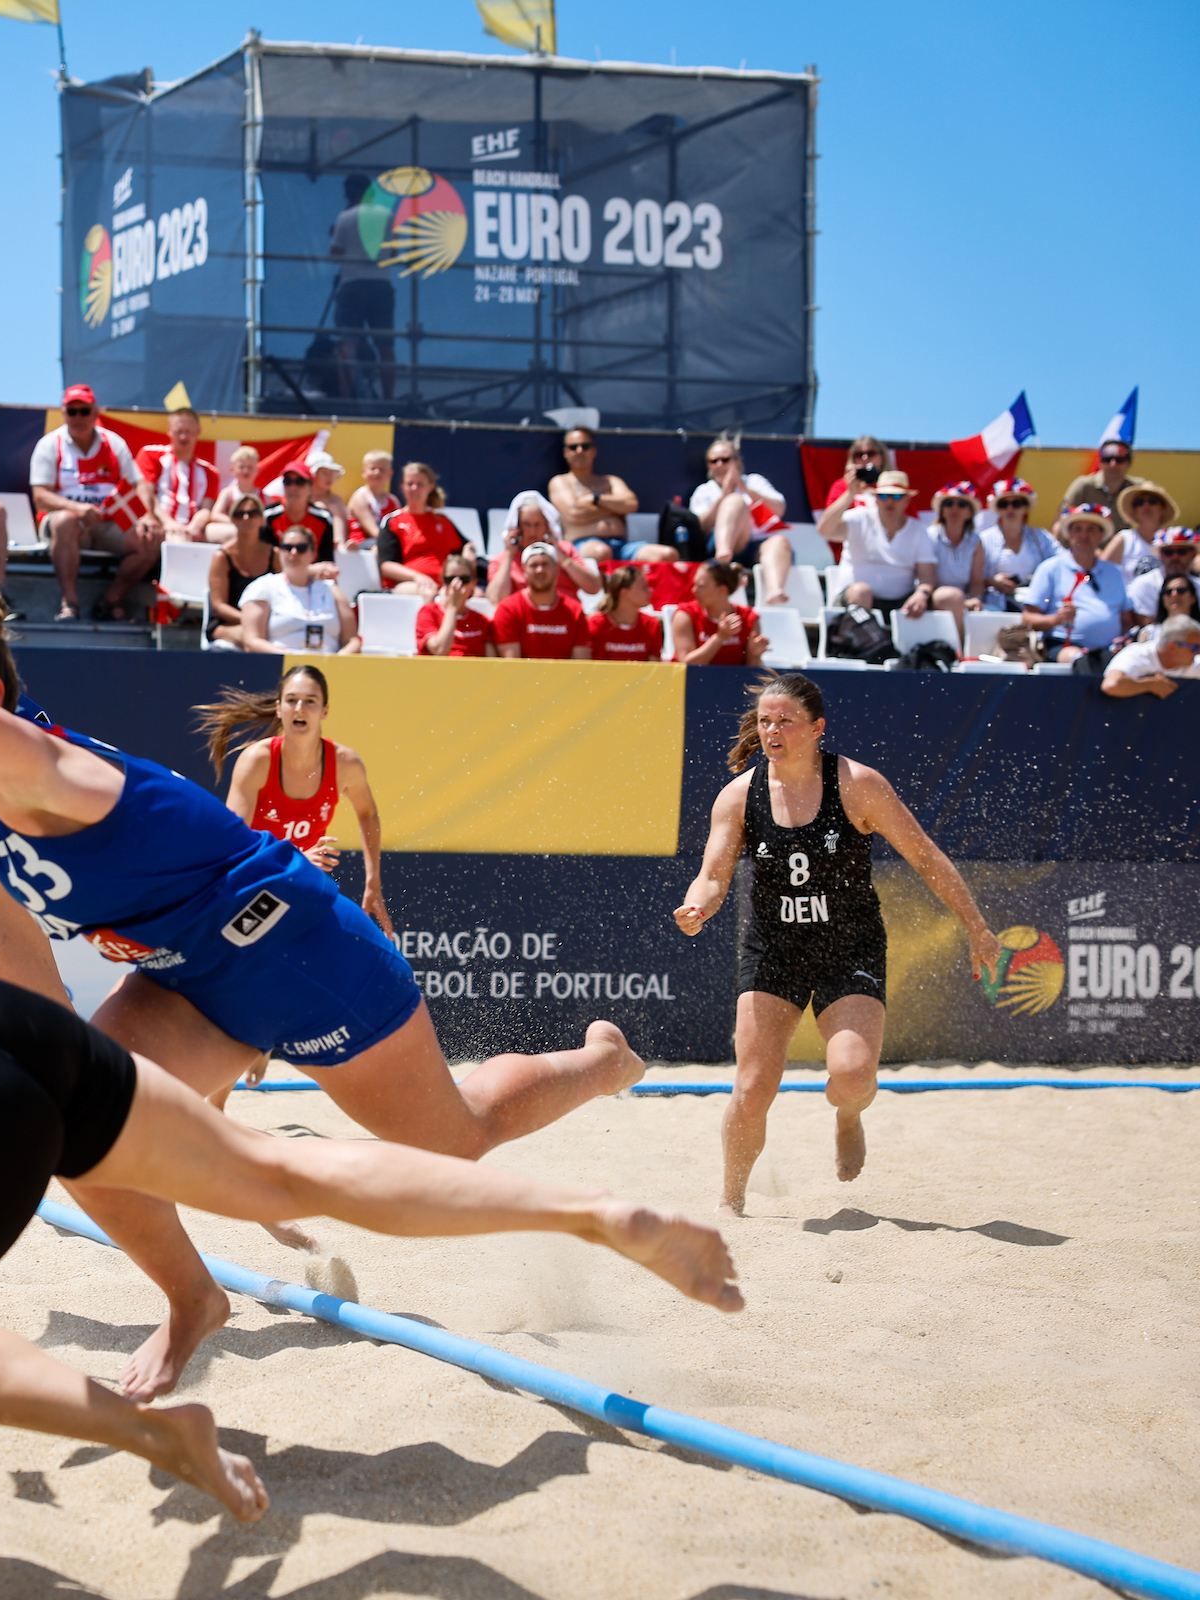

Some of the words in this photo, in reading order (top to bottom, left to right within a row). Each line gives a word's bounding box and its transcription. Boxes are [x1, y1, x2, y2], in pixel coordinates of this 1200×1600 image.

[473, 128, 521, 156] EHF
[473, 191, 591, 263] EURO
[603, 197, 723, 270] 2023
[112, 219, 156, 298] EURO
[156, 197, 209, 281] 2023
[283, 820, 311, 840] 10
[788, 852, 811, 887] 8
[780, 894, 829, 923] DEN
[1067, 891, 1106, 916] EHF
[521, 932, 557, 960] DE
[490, 971, 526, 999] DE
[535, 972, 677, 1000] PORTUGAL
[1068, 943, 1160, 999] EURO
